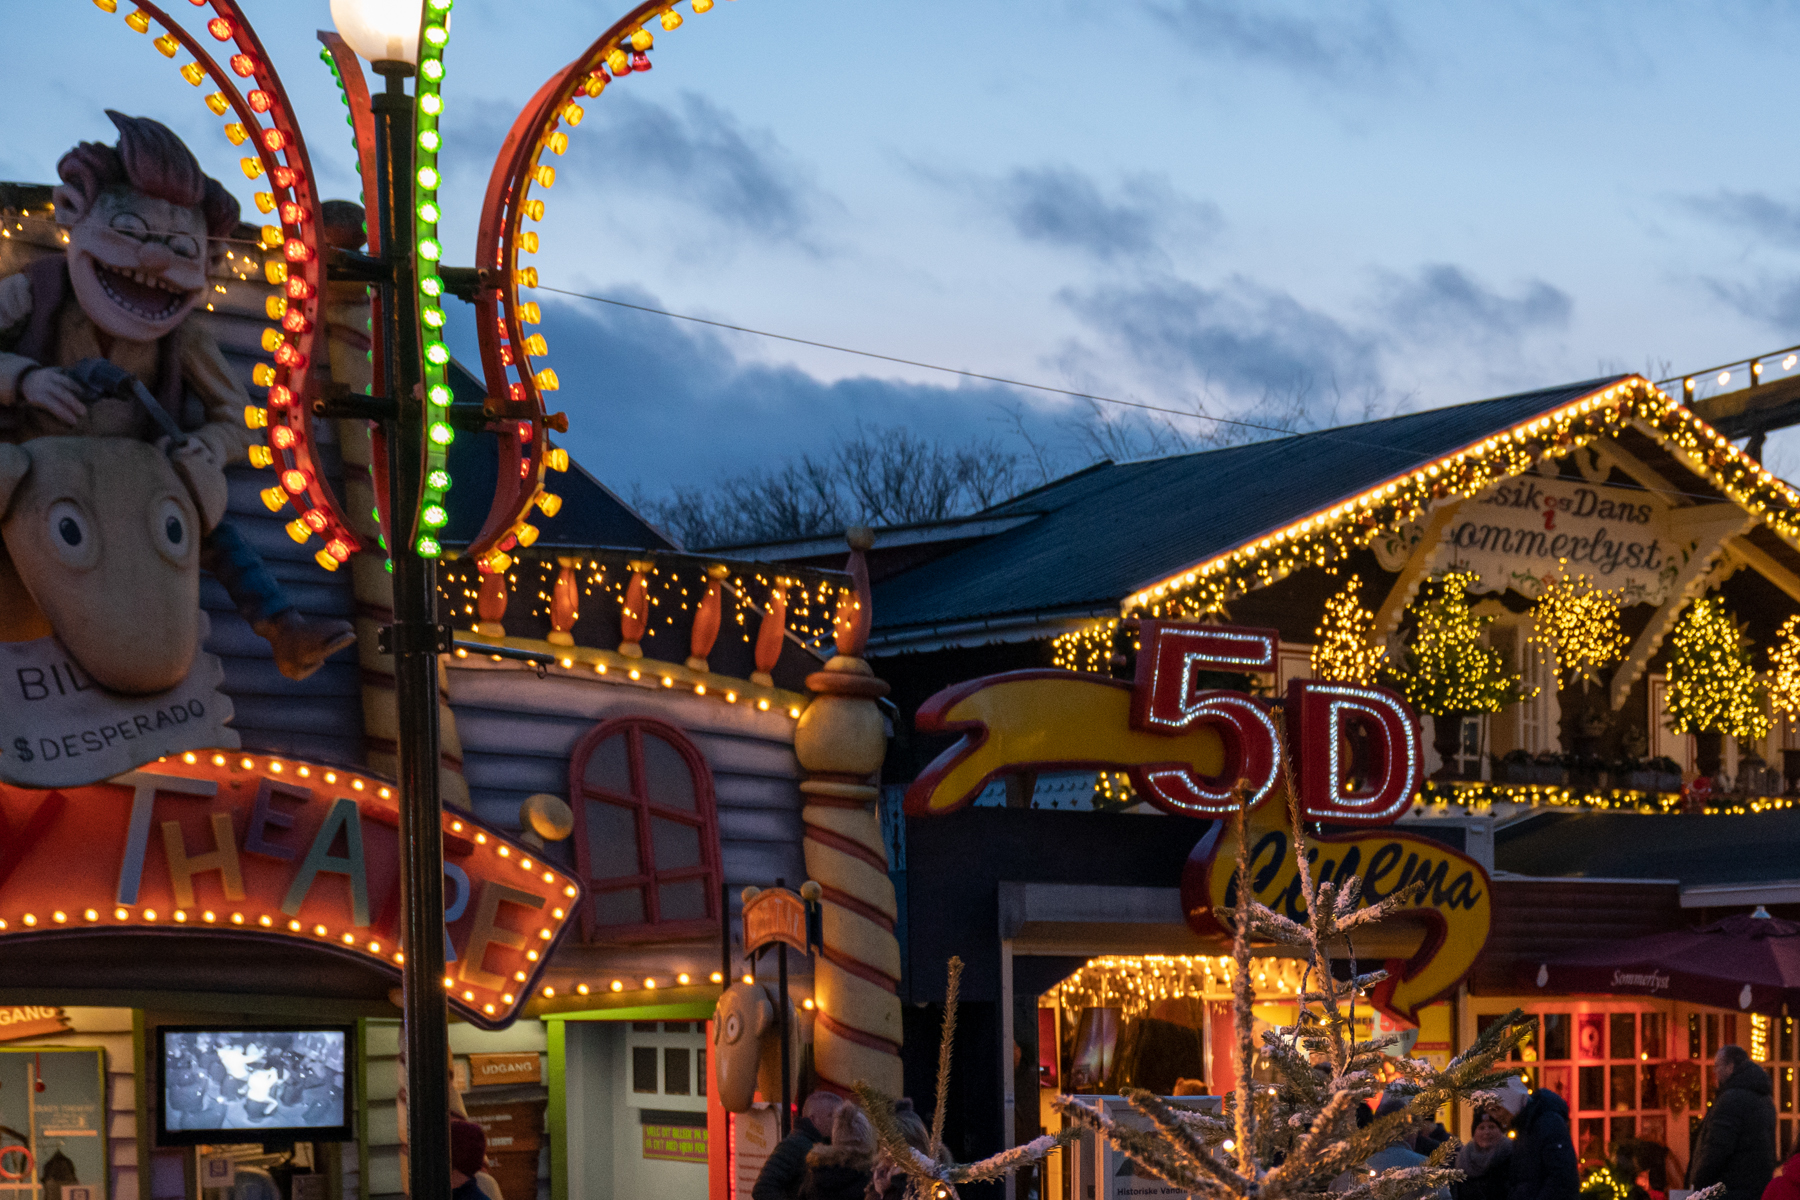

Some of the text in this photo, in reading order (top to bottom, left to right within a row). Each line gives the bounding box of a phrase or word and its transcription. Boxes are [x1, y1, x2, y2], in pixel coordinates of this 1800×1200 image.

[1571, 487, 1653, 525] Dans
[1449, 521, 1662, 575] ommerlyst
[39, 699, 205, 762] DESPERADO
[1134, 620, 1421, 820] 5D
[1224, 830, 1482, 931] Cinema
[481, 1061, 533, 1075] UDGANG
[1117, 1187, 1158, 1196] Historiske
